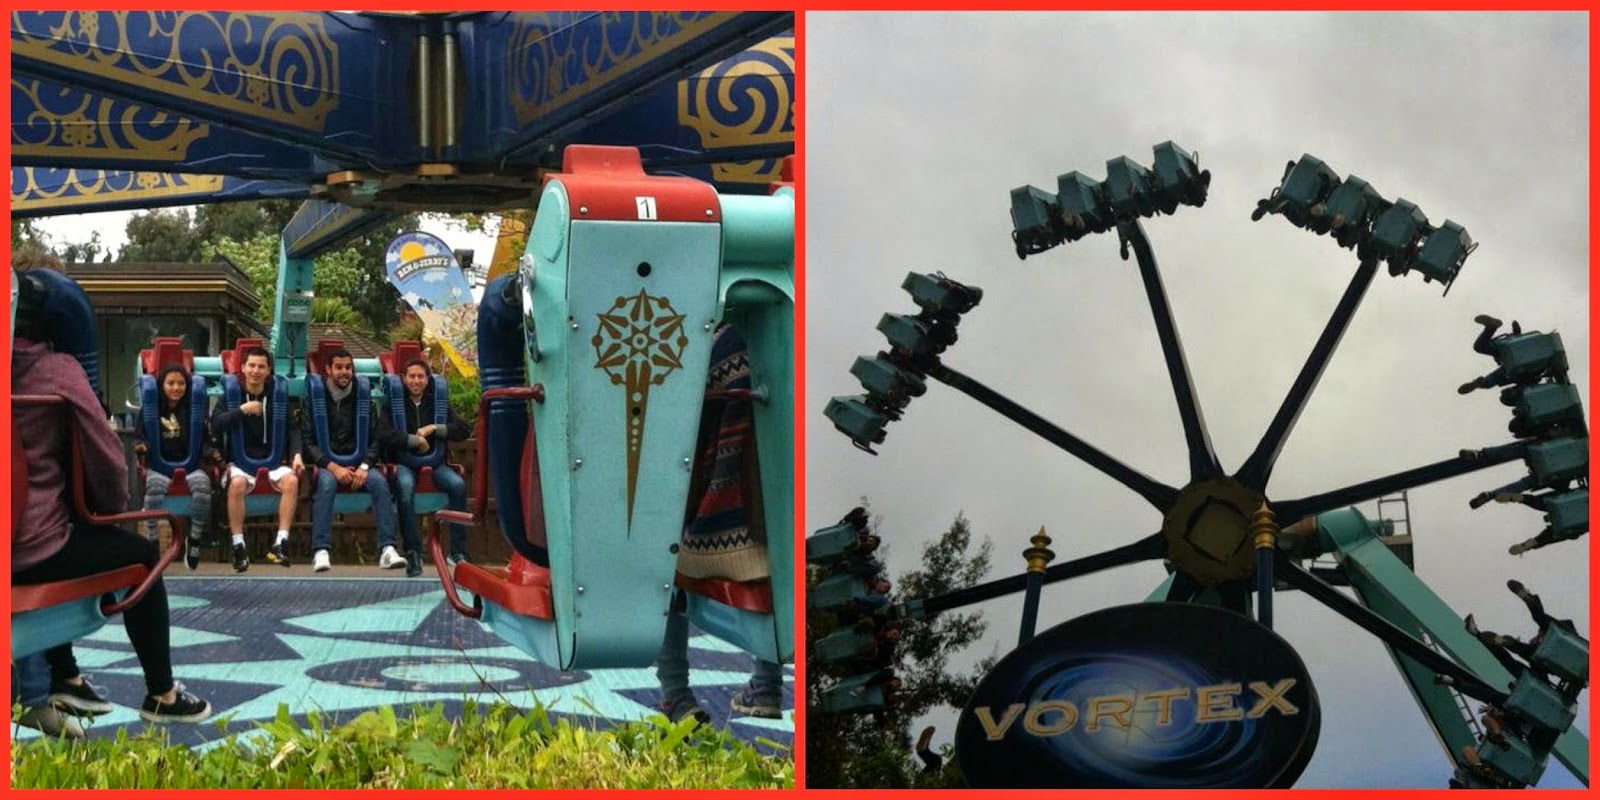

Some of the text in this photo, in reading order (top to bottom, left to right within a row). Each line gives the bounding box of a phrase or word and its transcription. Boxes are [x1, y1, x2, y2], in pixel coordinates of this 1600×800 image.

[640, 198, 650, 218] 1
[398, 263, 413, 278] BEN
[419, 257, 449, 267] JERRY'S
[974, 678, 1299, 741] VORTEX
